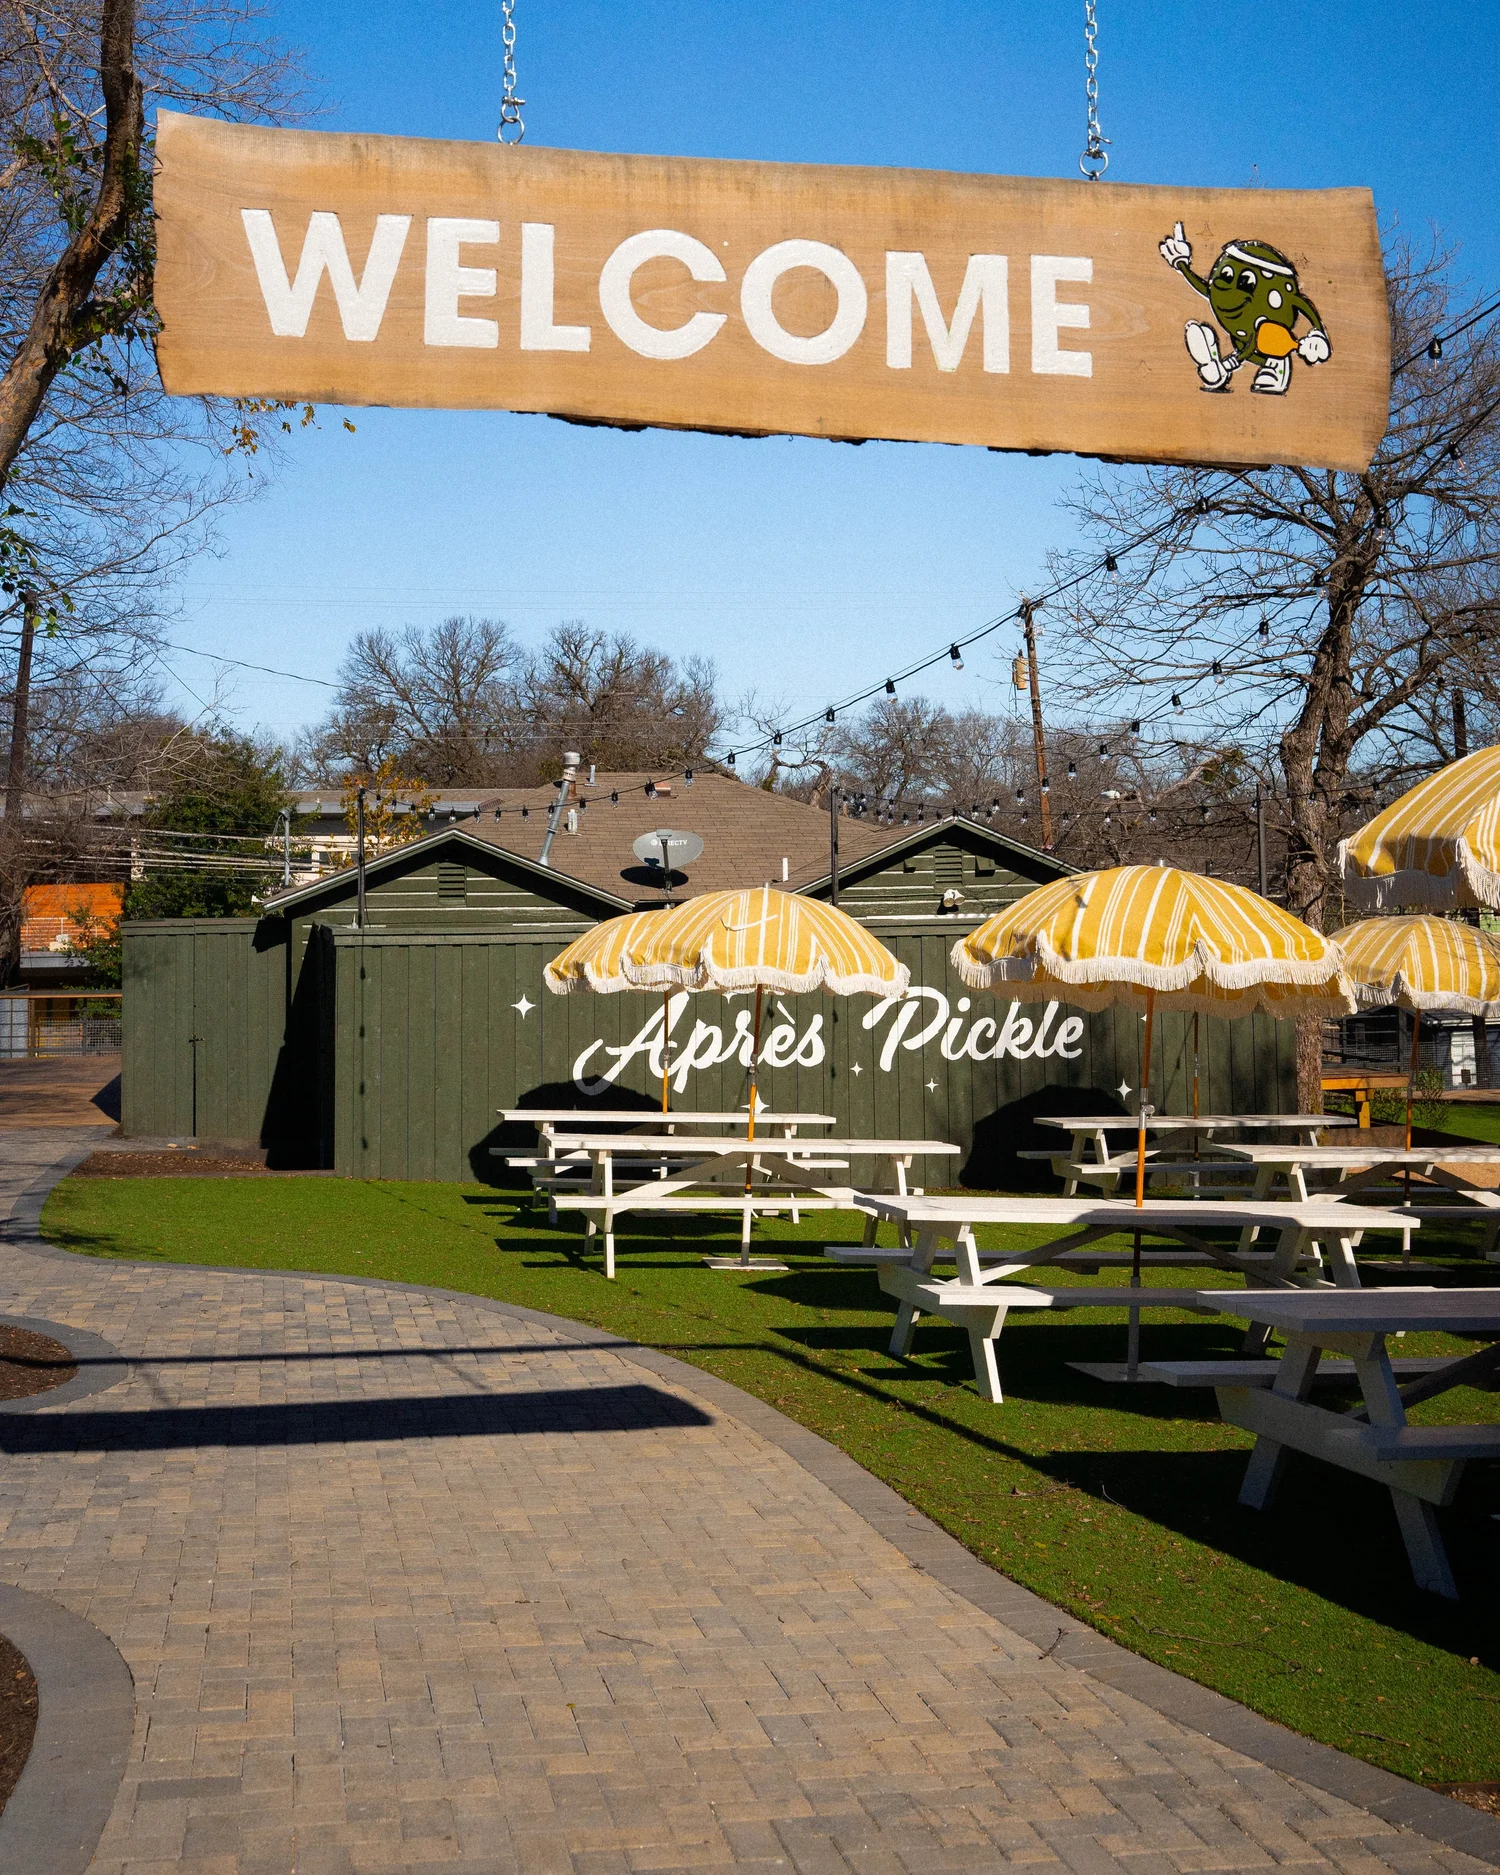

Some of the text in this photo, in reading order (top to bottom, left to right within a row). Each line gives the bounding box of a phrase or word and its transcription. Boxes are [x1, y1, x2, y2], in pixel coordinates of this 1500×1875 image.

[241, 208, 1093, 377] WELCOME
[573, 986, 1084, 1096] Après Pickle
